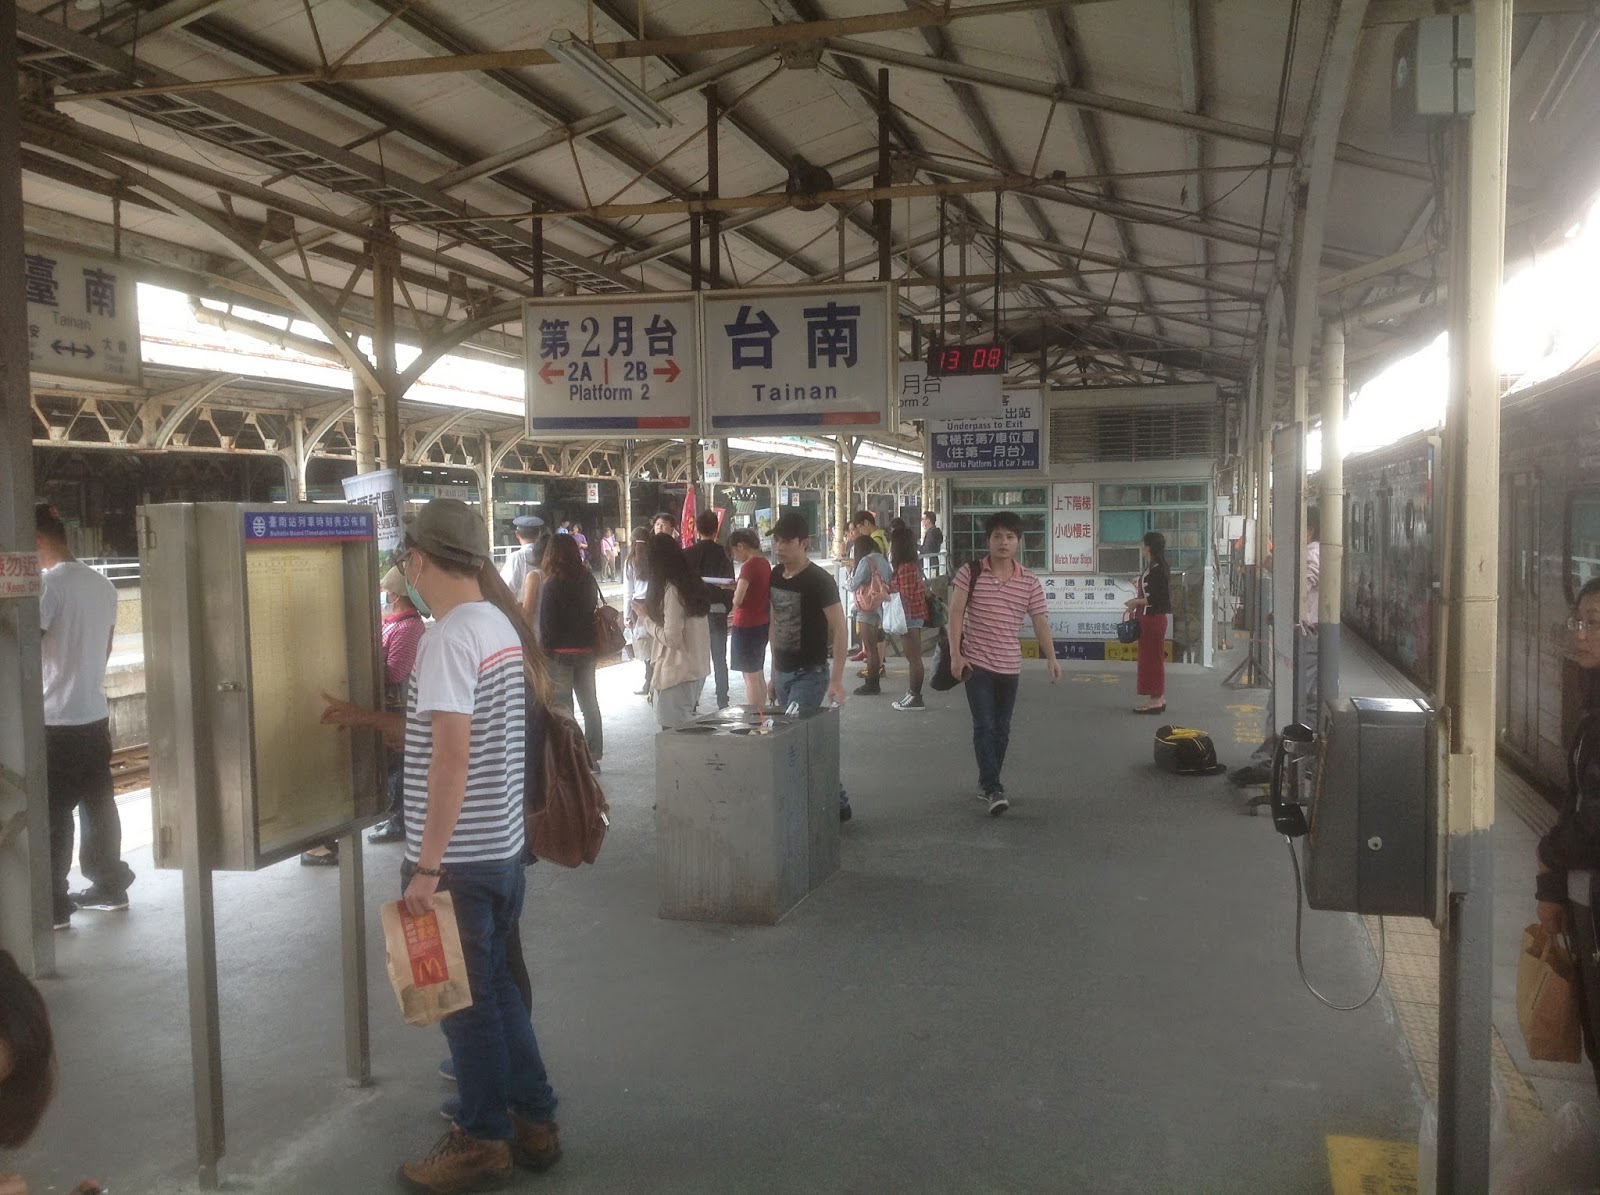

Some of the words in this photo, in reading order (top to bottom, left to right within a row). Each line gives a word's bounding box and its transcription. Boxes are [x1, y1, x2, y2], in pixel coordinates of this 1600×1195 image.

[52, 310, 92, 331] Tainan
[538, 313, 678, 360] 第2月台
[724, 302, 860, 370] 台南
[940, 350, 961, 370] 13
[972, 347, 1002, 369] 08
[568, 362, 592, 382] 2A
[623, 361, 648, 381] 2B
[569, 383, 632, 401] Platform
[640, 384, 650, 401] 2
[752, 384, 837, 403] Tainan
[922, 396, 929, 407] 2
[947, 421, 991, 431] Underpass
[994, 421, 1003, 429] to
[1005, 420, 1023, 429] Exit
[706, 453, 717, 467] 4
[936, 460, 960, 470] Elevator
[961, 460, 967, 468] to
[968, 458, 992, 469] Platform
[1005, 458, 1016, 467] Car
[1055, 495, 1092, 511] 上下階梯
[1055, 523, 1091, 539] 小心慢走
